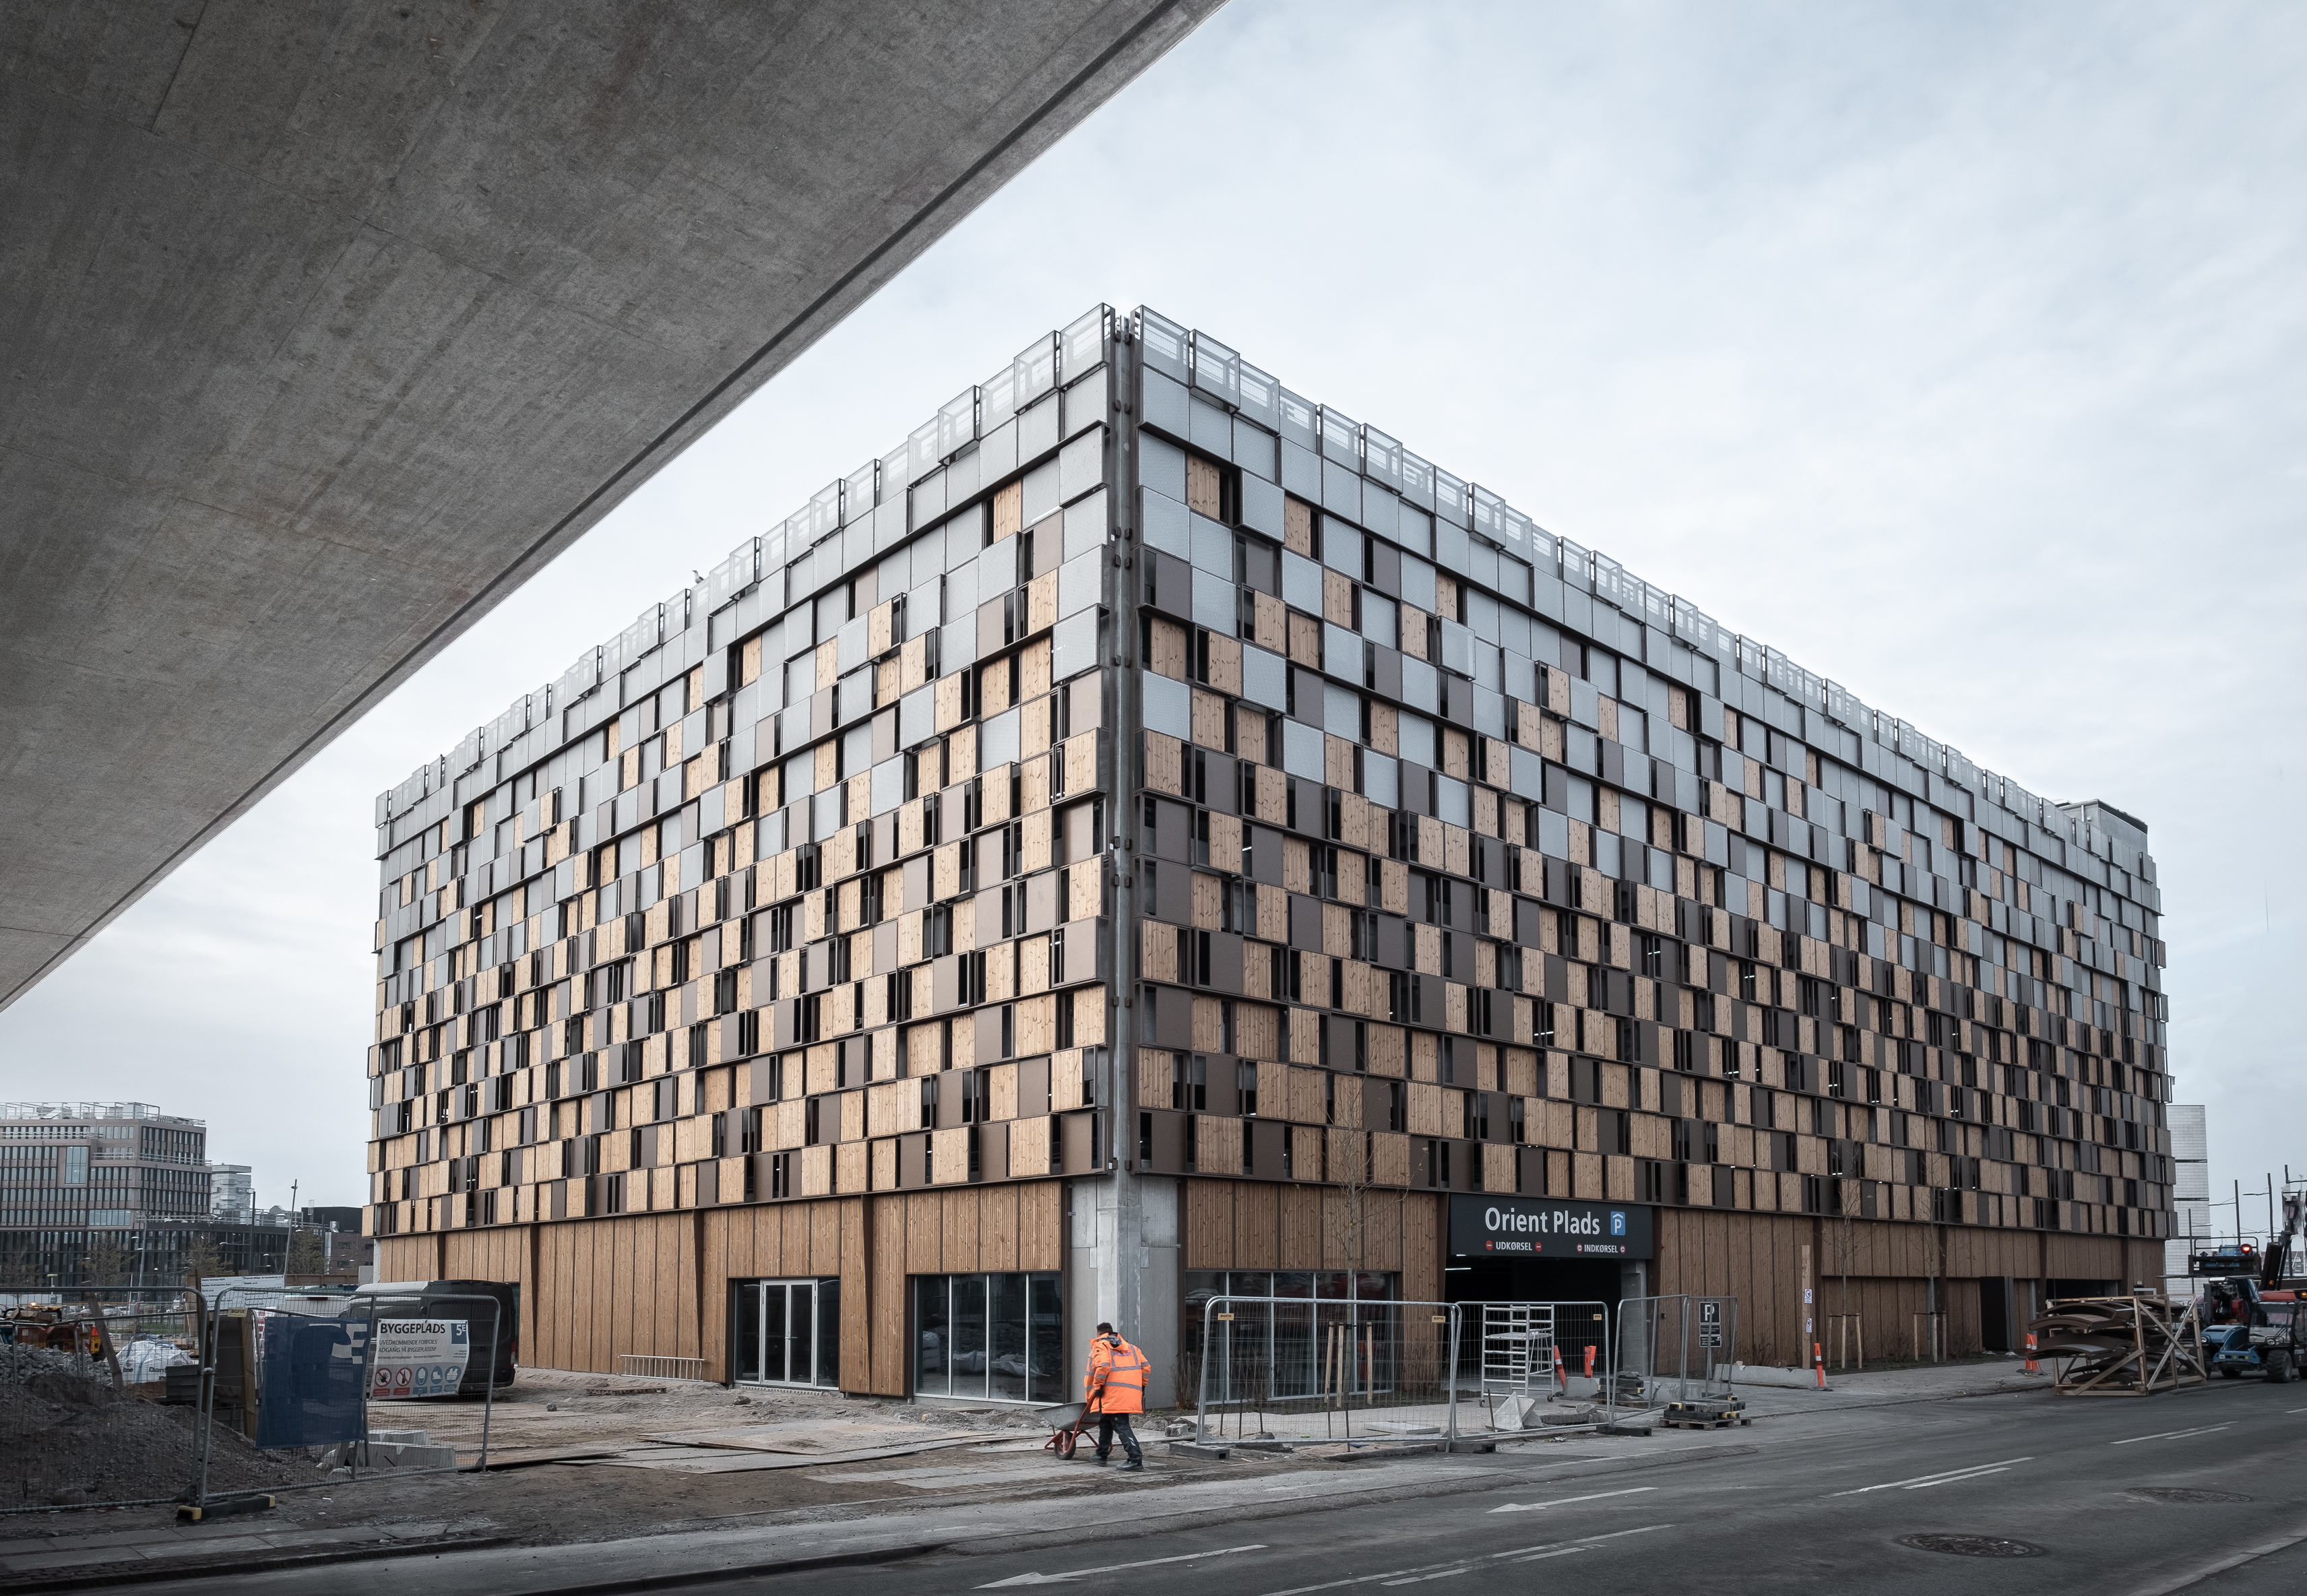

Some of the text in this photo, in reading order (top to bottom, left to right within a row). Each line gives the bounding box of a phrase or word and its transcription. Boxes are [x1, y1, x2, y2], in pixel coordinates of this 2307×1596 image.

[1485, 1207, 1600, 1235] Orient Plads
[1614, 1219, 1622, 1234] P
[1496, 1242, 1533, 1251] UDKØRSEL
[1584, 1244, 1618, 1253] INDKØRSEL
[1705, 1304, 1715, 1321] P
[381, 1323, 446, 1334] BYGGEPLADS
